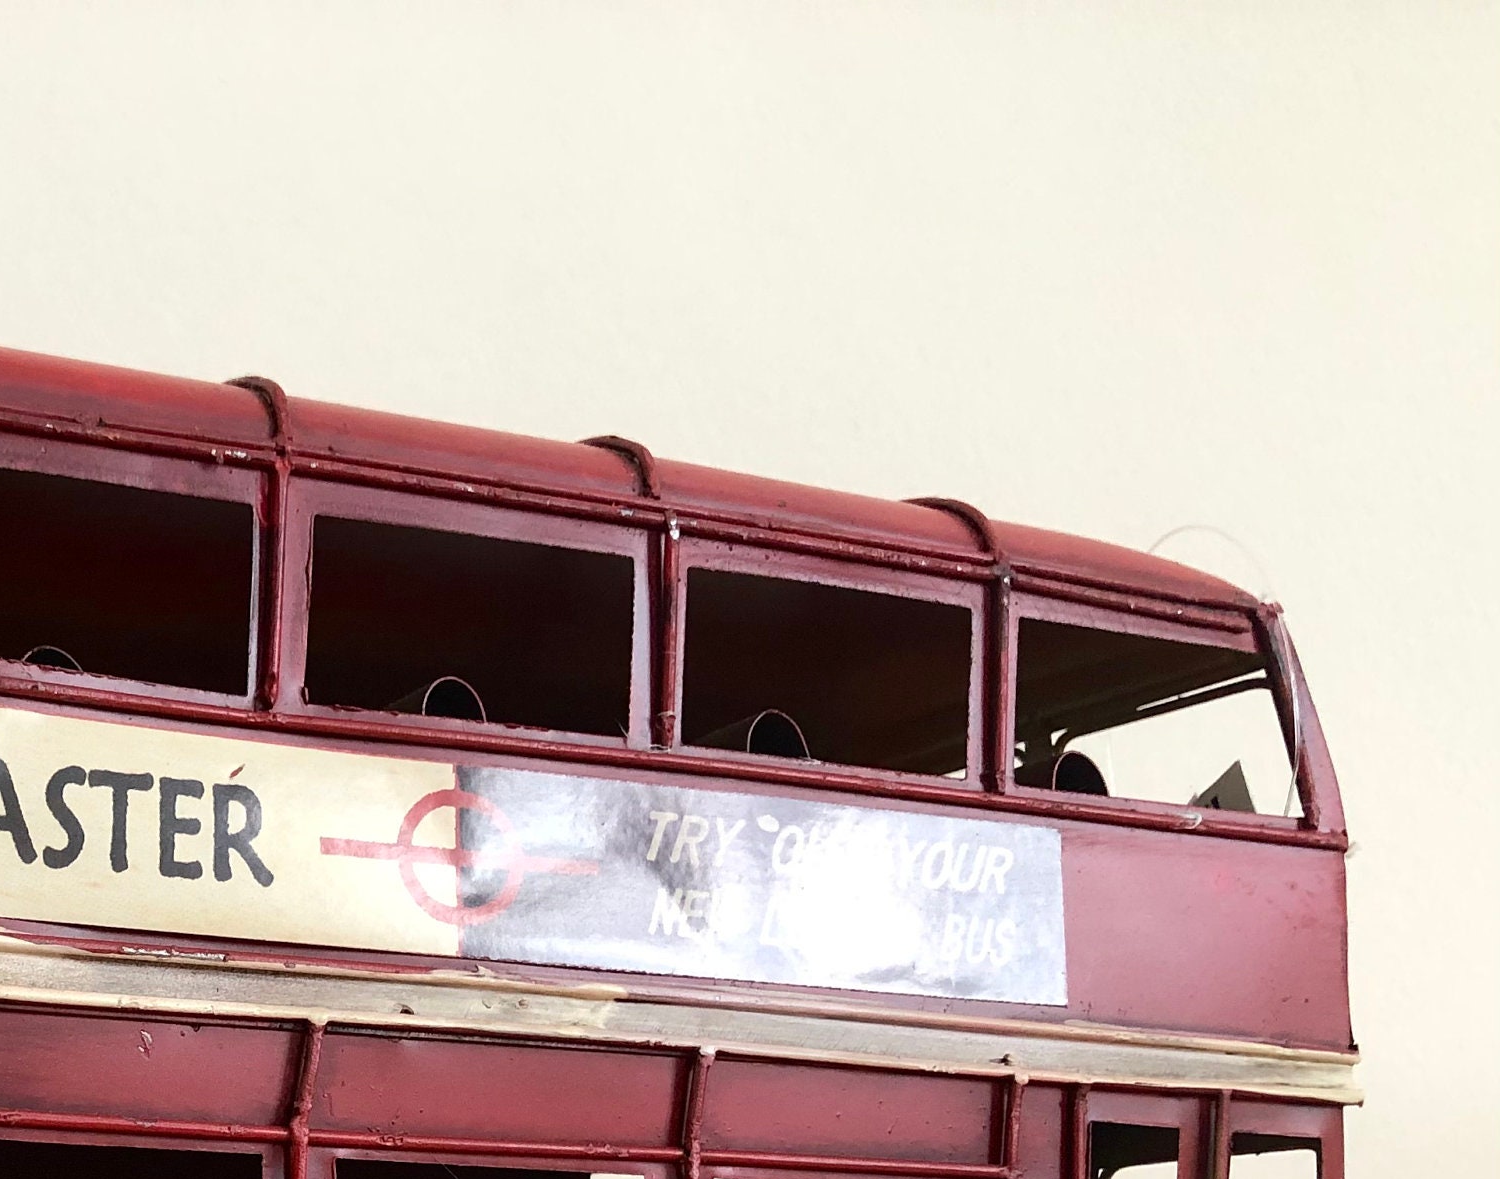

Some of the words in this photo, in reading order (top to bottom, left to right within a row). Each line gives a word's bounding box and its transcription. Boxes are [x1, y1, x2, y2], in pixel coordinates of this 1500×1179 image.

[646, 810, 747, 868] TRY
[894, 836, 1015, 895] YOUR
[648, 887, 752, 944] NE
[941, 912, 1016, 967] BUS
